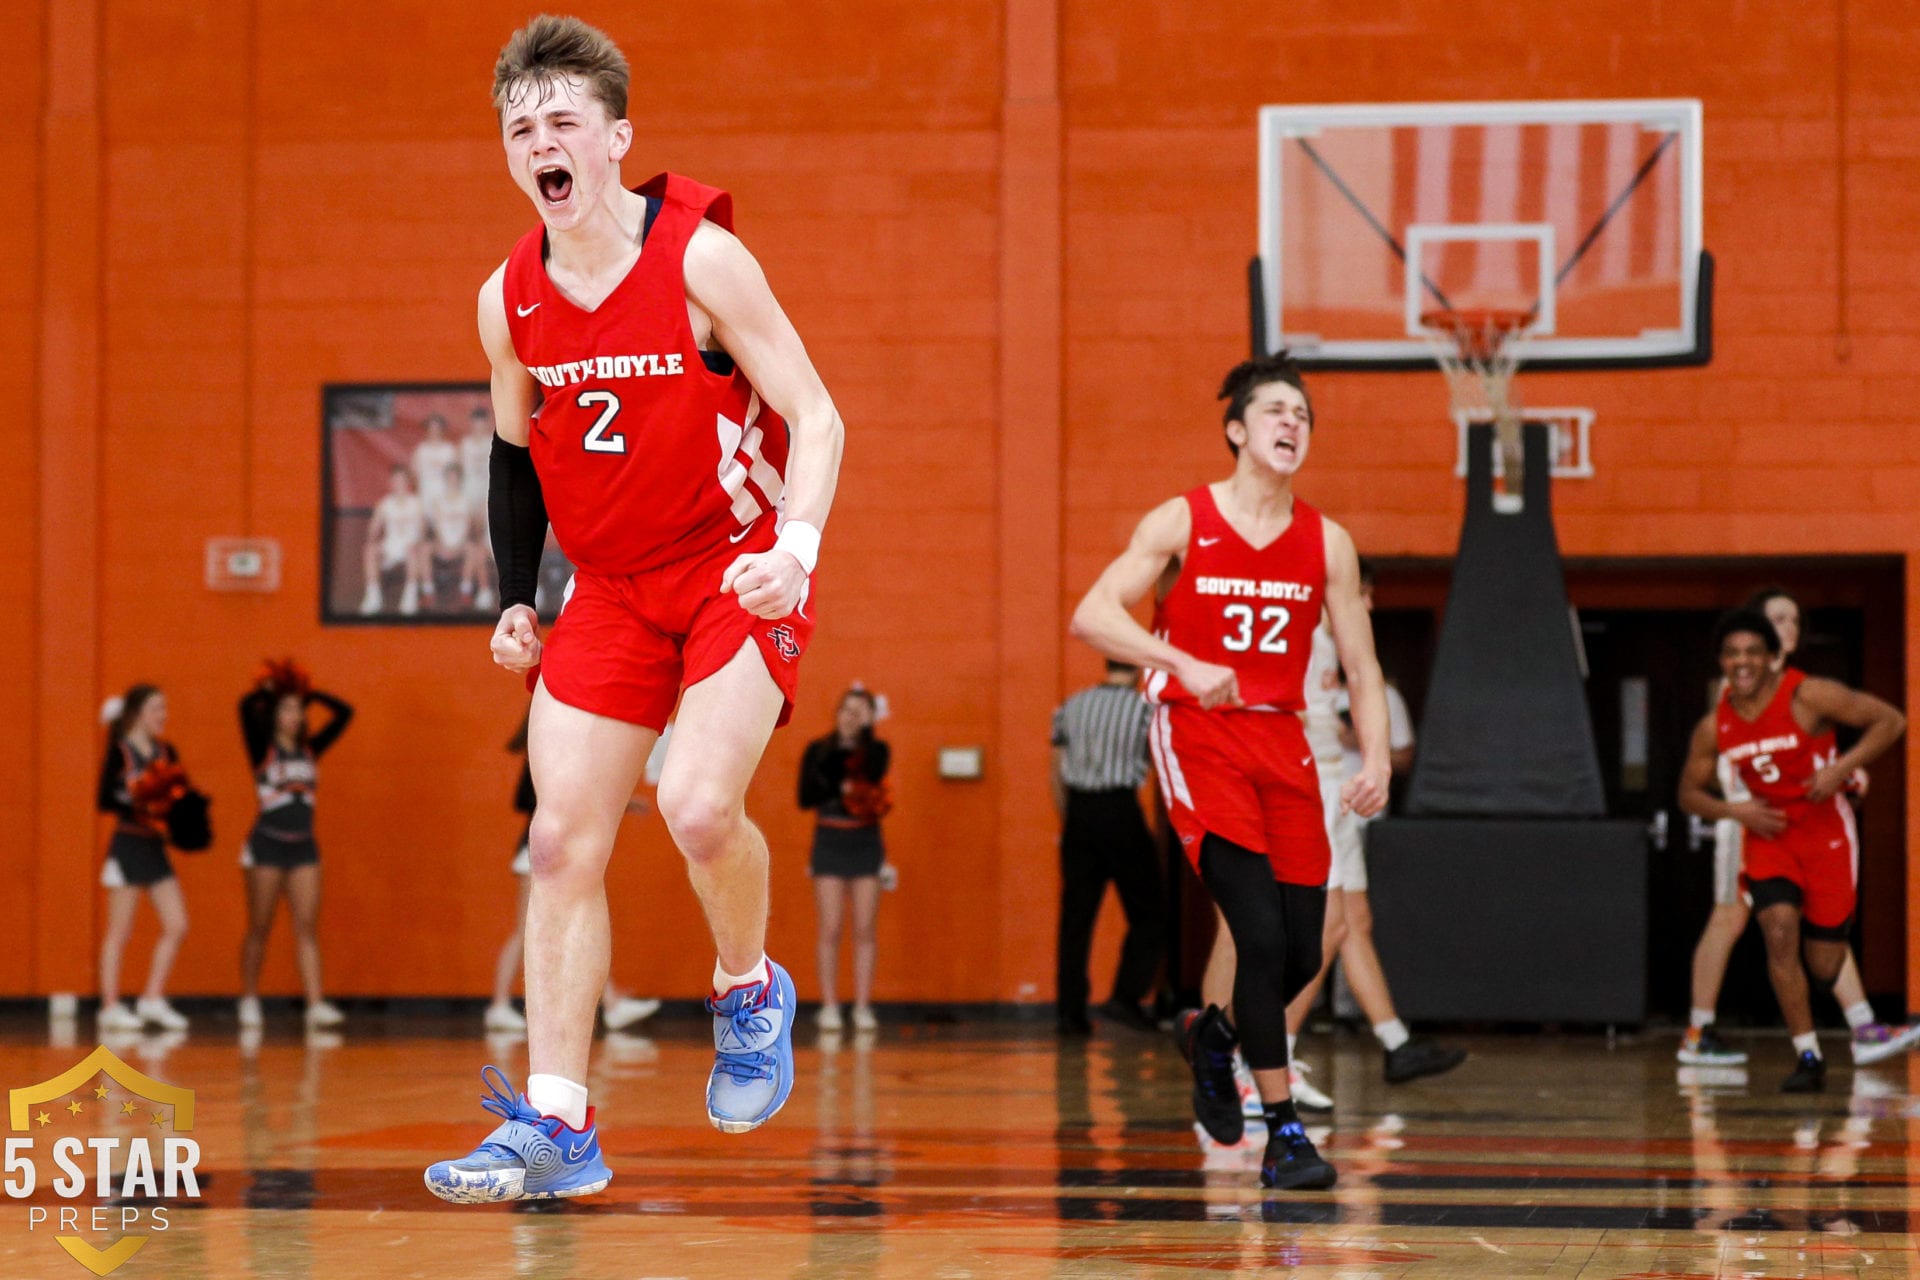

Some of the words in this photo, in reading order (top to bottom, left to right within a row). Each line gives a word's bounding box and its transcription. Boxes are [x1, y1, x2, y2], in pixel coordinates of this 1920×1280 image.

[577, 390, 627, 454] 2
[1222, 603, 1290, 654] 32
[1751, 753, 1781, 783] 5
